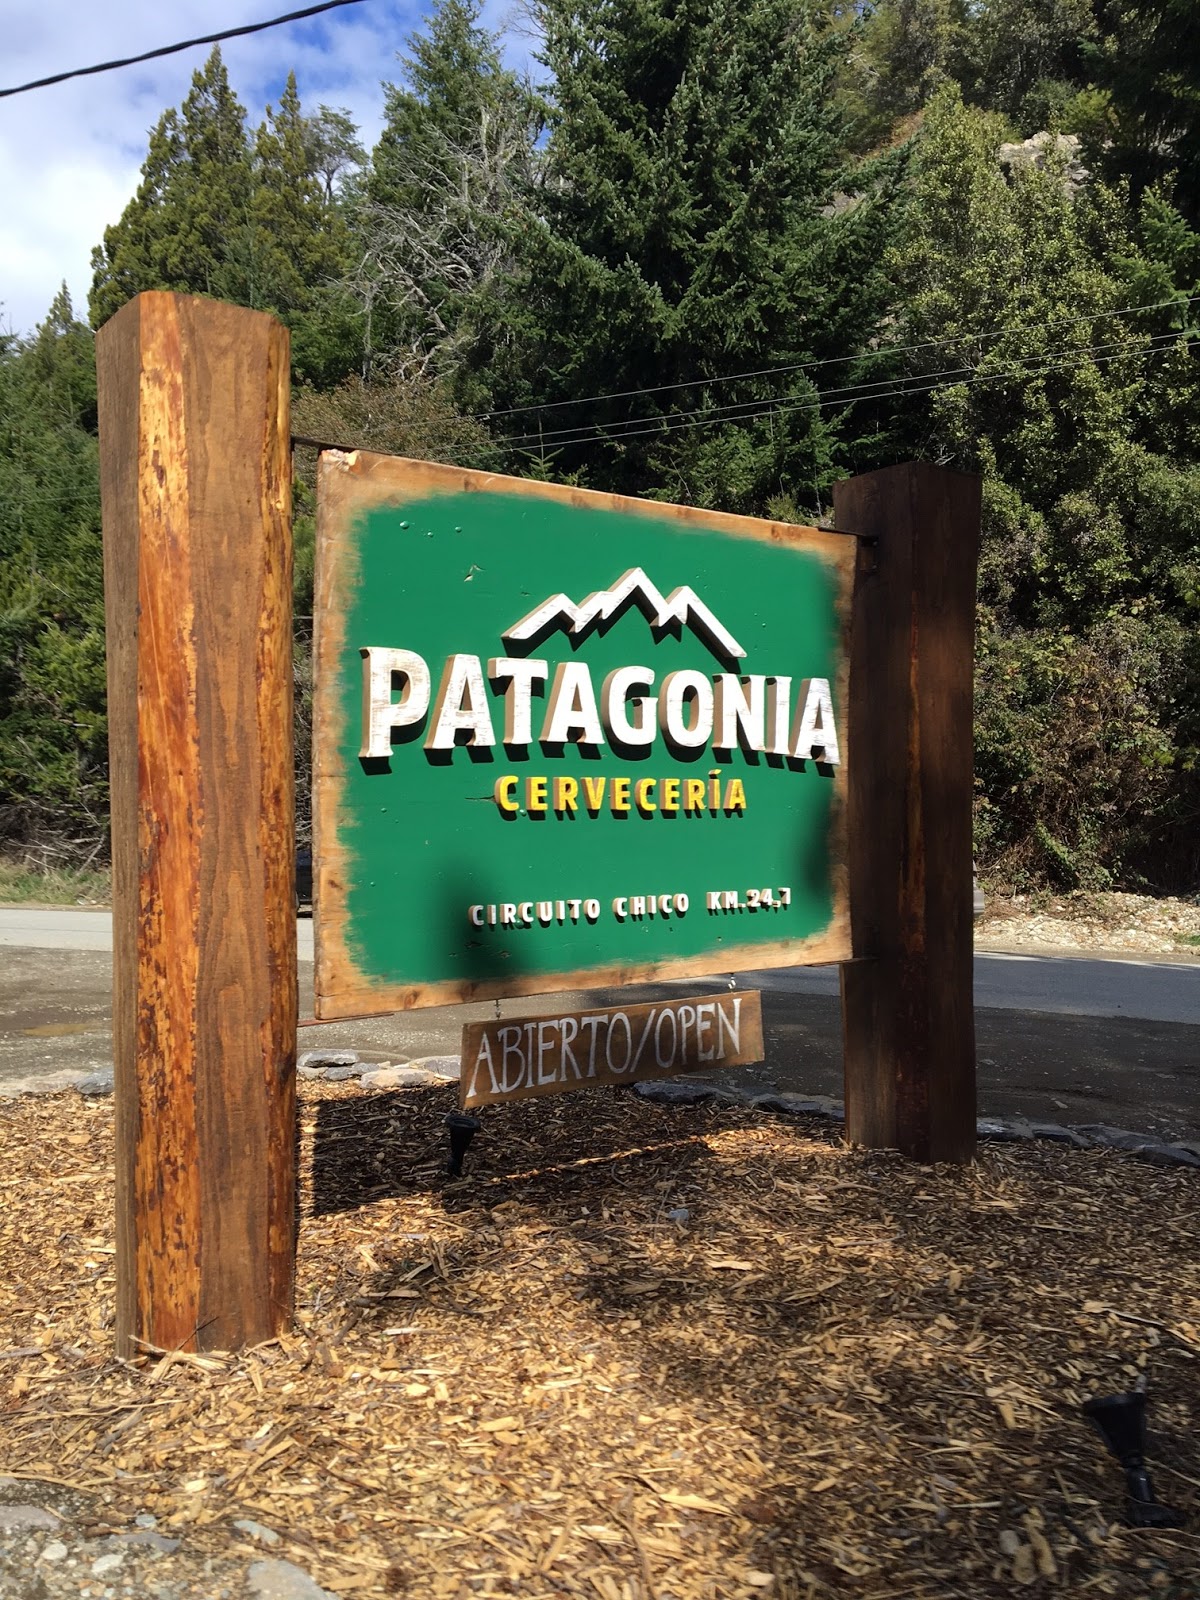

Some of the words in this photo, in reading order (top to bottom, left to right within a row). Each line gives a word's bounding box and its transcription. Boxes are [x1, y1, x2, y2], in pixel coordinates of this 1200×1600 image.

[359, 646, 841, 766] PATAGONIA
[493, 769, 747, 813] CERVECERÍA
[468, 899, 601, 927] CIRCUITO
[612, 893, 690, 918] CHICO
